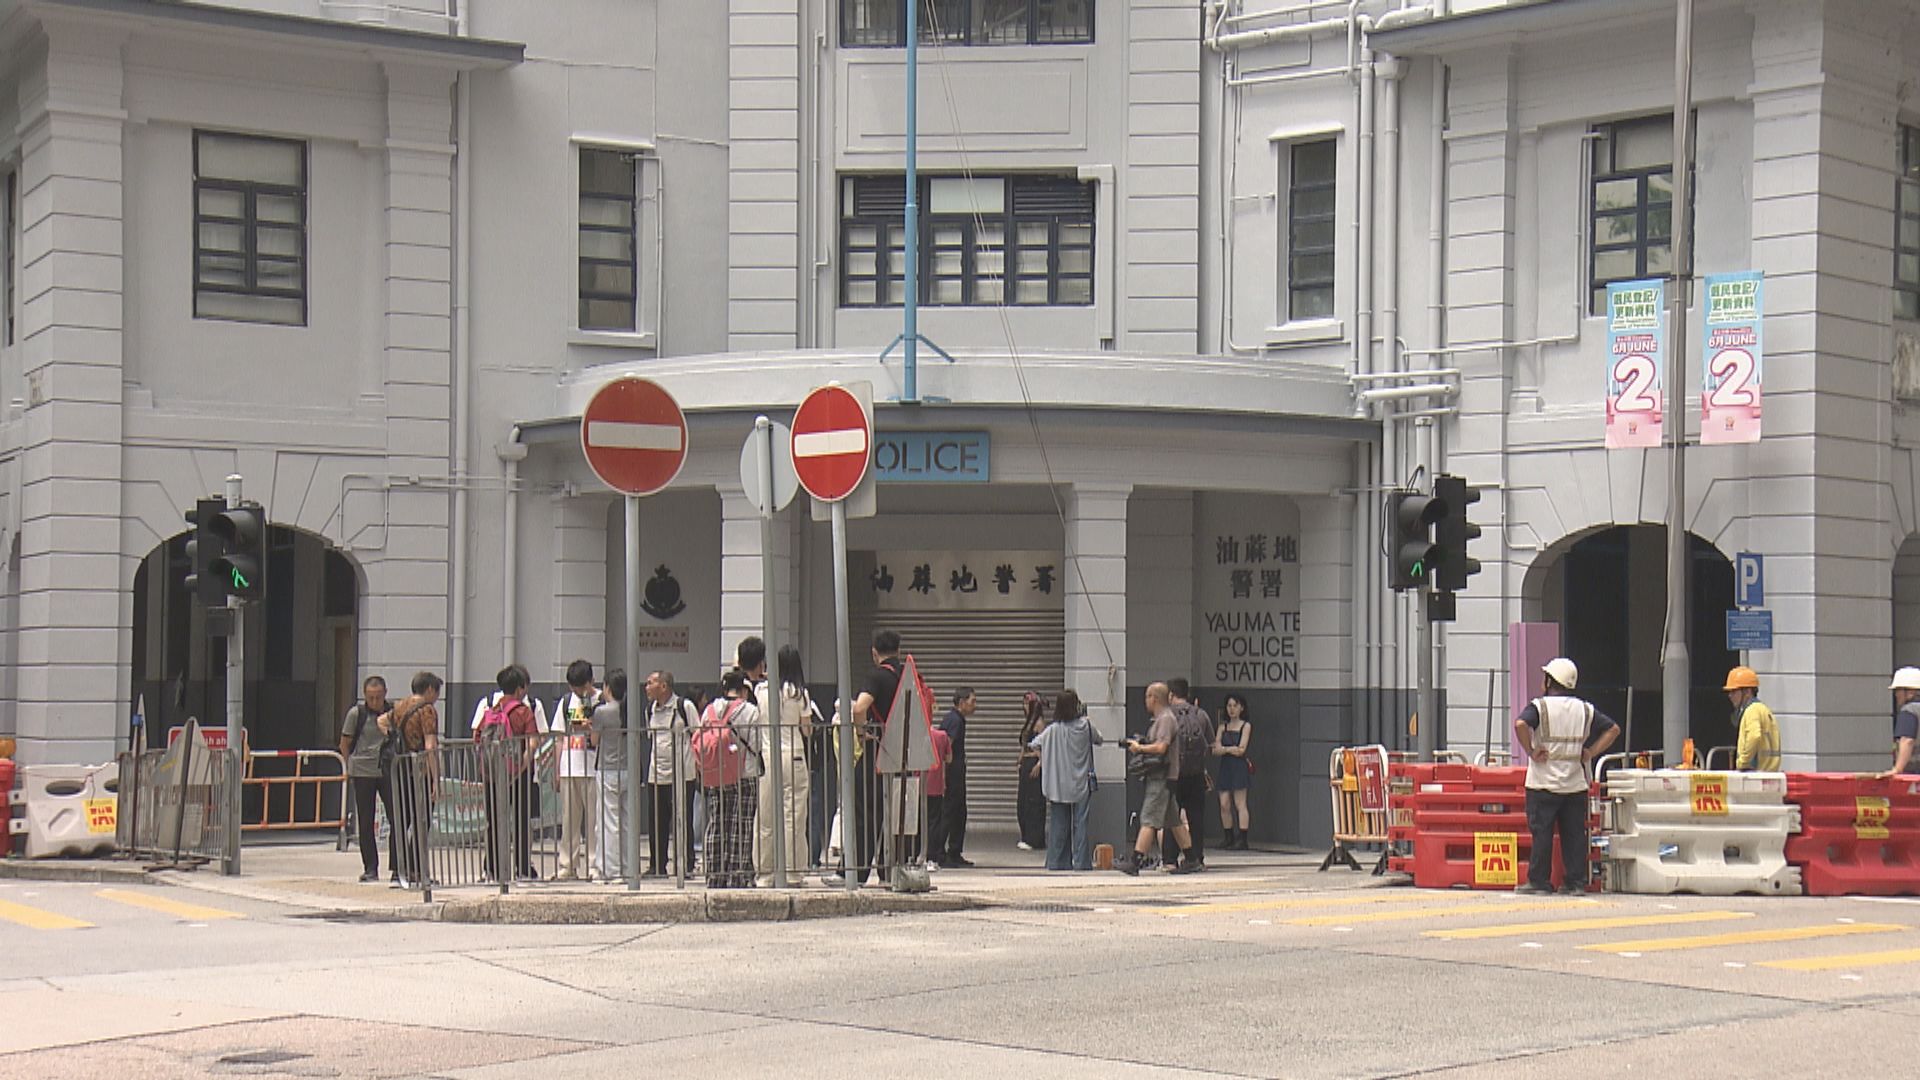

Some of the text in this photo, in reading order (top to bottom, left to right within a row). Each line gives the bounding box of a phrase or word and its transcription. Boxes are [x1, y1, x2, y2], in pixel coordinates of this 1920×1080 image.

[1627, 340, 1658, 353] JUNE
[1724, 333, 1757, 347] JUNE
[1613, 354, 1656, 412] 2
[1709, 348, 1756, 407] 2
[875, 441, 980, 473] OLICE
[1230, 569, 1282, 599] 警署
[1740, 558, 1759, 601] P
[1205, 612, 1301, 632] YAU MA TE
[1218, 637, 1295, 657] POLICE
[1216, 662, 1297, 682] STATION
